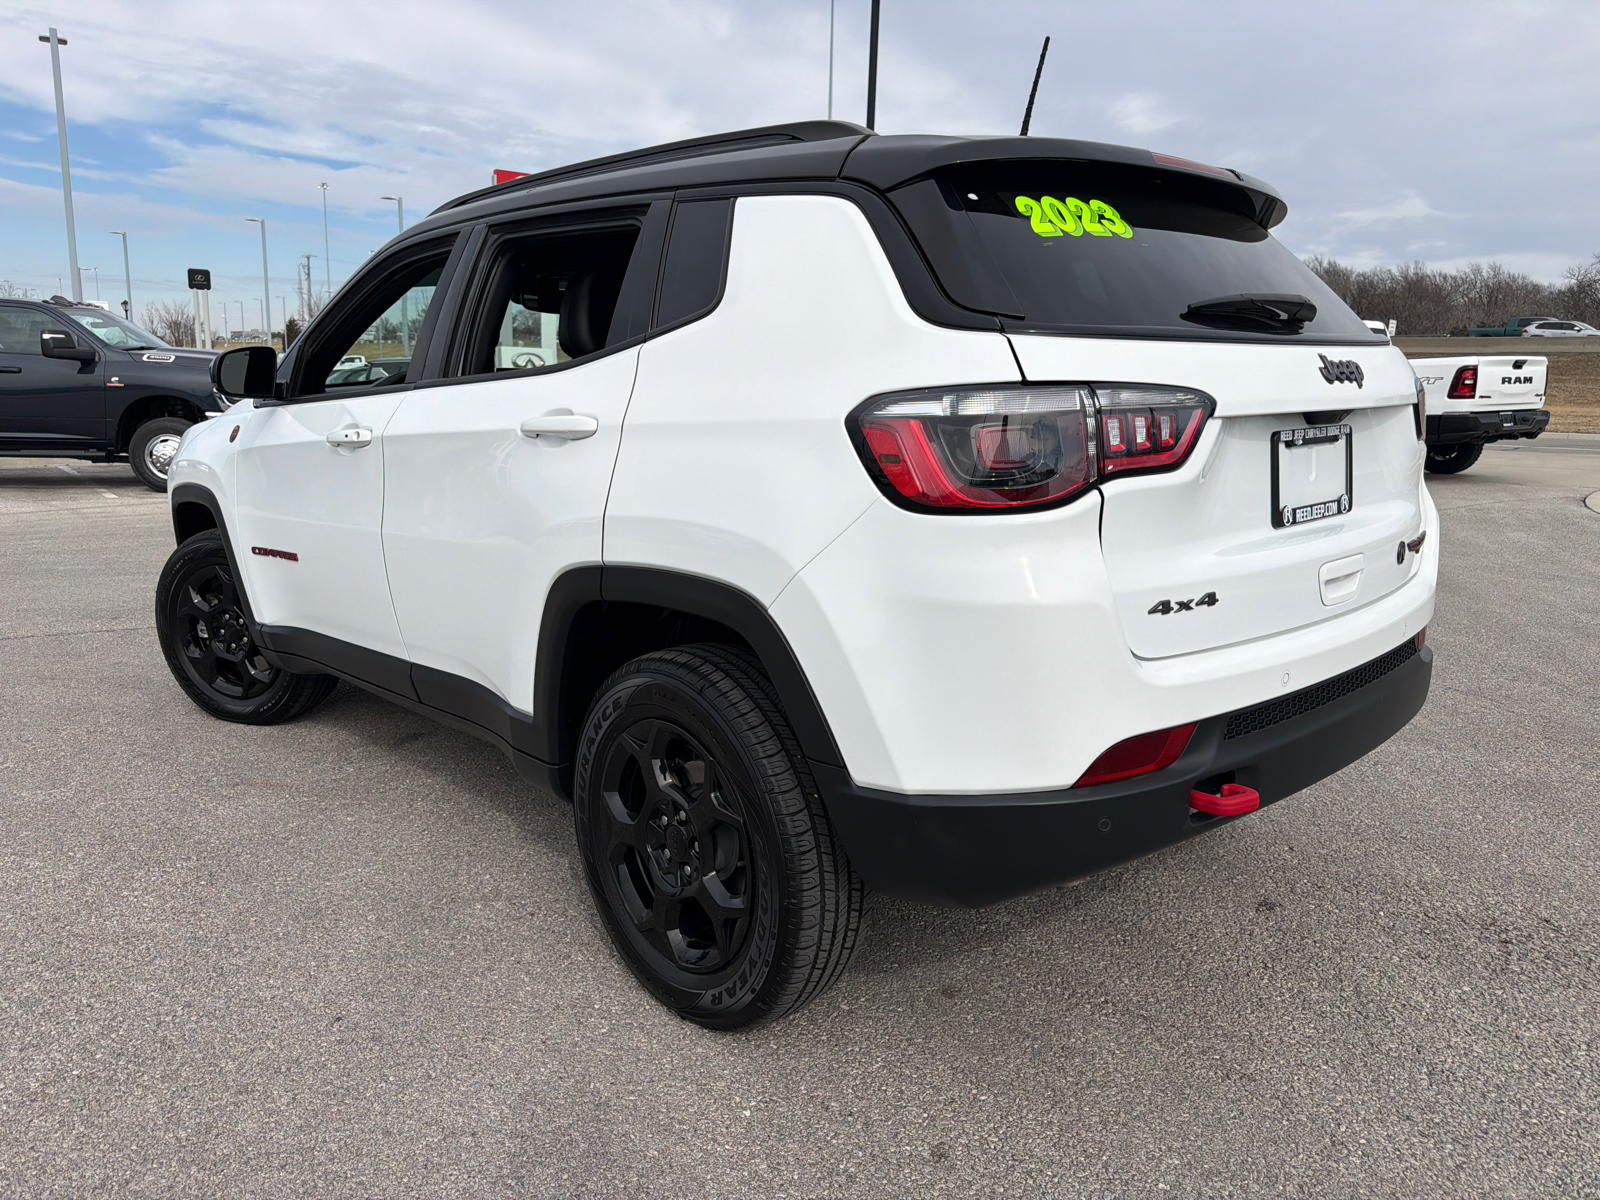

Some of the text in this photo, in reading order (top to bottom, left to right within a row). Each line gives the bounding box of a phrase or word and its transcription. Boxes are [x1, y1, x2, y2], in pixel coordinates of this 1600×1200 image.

[1015, 196, 1133, 238] 2023
[1317, 352, 1365, 390] Jeep
[1501, 376, 1533, 385] RAM
[1280, 430, 1293, 442] REED
[1294, 429, 1305, 439] JEEP
[1305, 427, 1327, 439] CHRYSLER
[1327, 426, 1340, 436] DODGE
[1296, 501, 1338, 523] REEDJEEP.COM
[1147, 591, 1220, 616] 4x4
